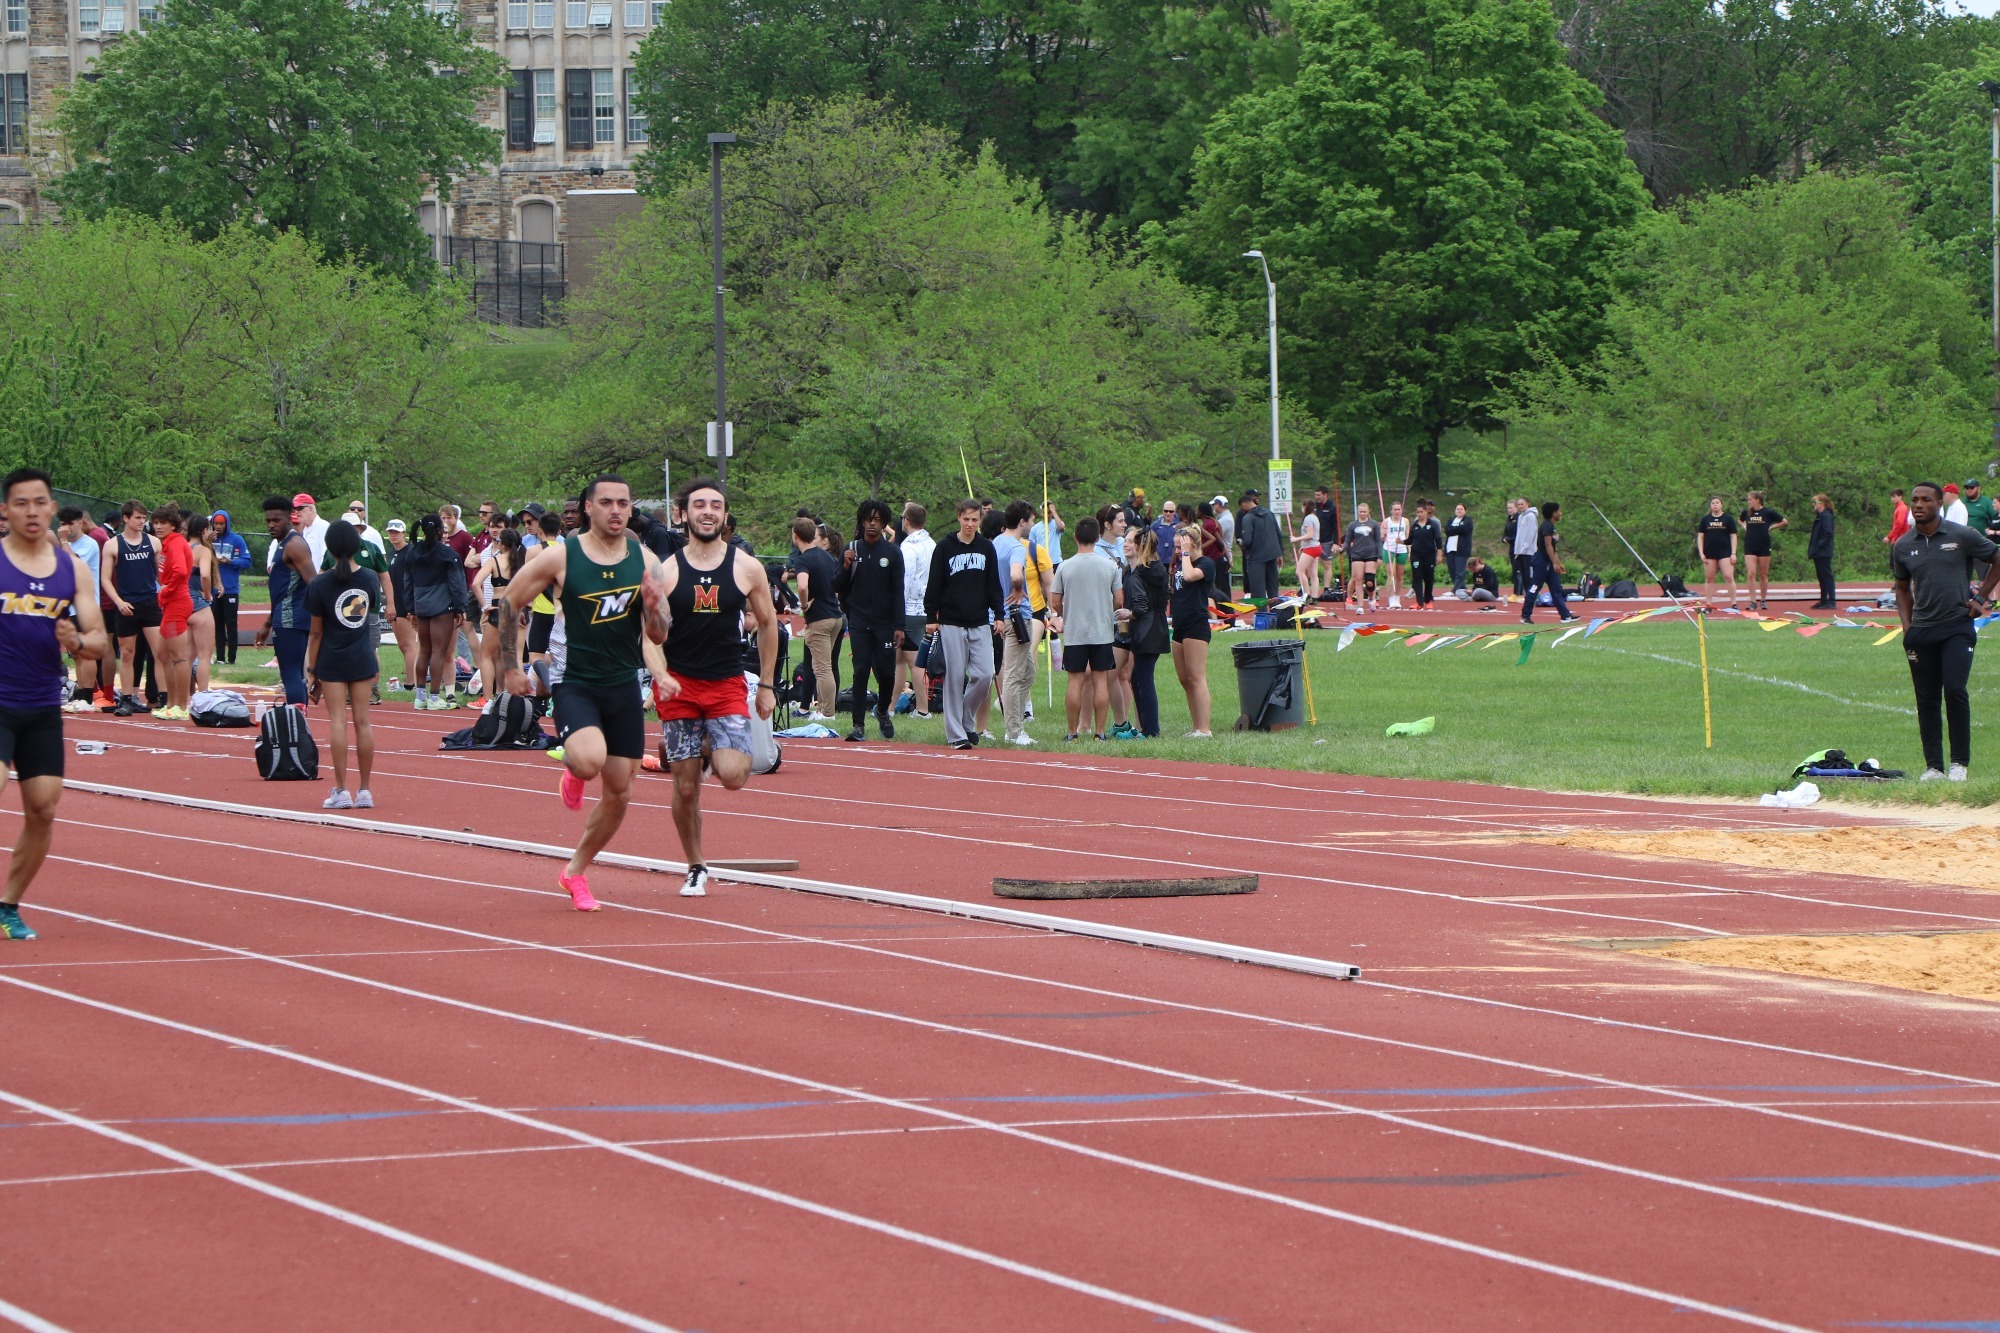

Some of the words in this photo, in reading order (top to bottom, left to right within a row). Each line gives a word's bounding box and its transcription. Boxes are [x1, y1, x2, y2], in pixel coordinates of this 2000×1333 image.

[1275, 488, 1287, 499] 30
[125, 552, 149, 560] UMW
[0, 592, 70, 619] WCU
[600, 591, 633, 617] M
[693, 585, 720, 609] M
